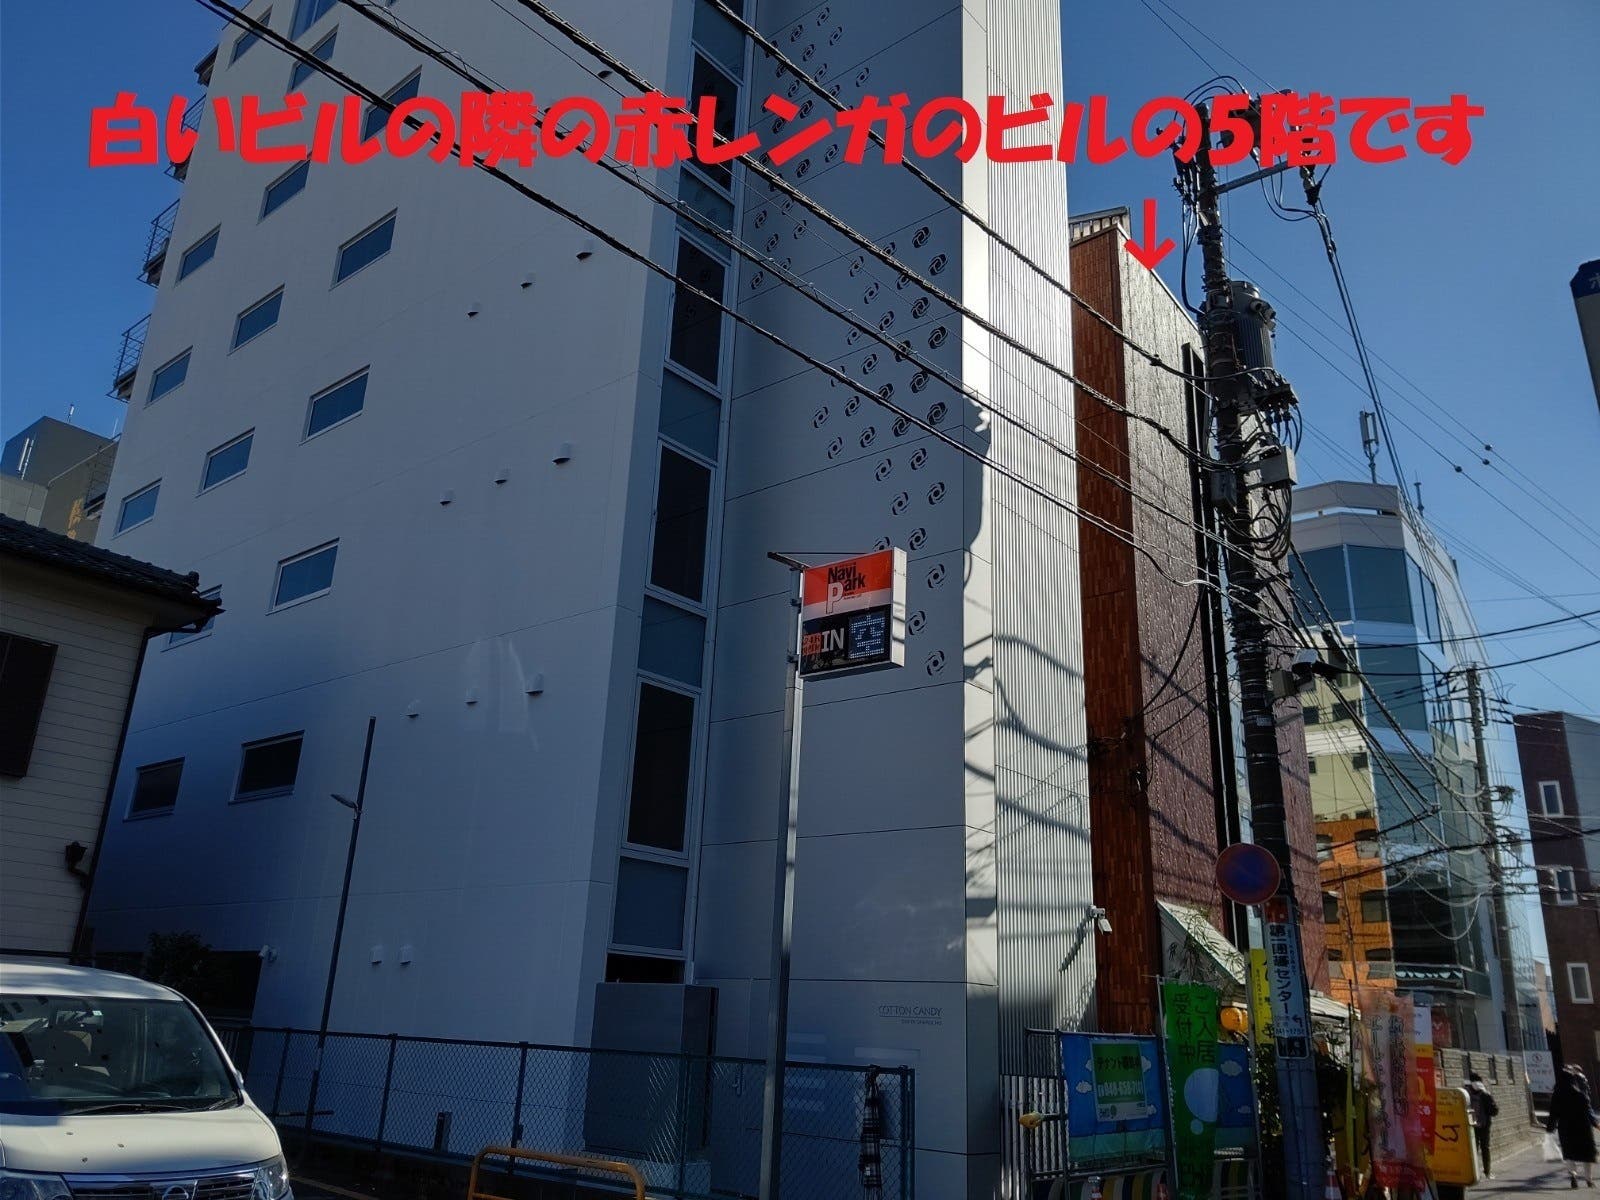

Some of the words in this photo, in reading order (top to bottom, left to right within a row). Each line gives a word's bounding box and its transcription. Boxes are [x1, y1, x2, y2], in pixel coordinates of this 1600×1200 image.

[828, 562, 856, 584] Navi
[826, 573, 866, 614] Park
[822, 627, 845, 653] IN
[913, 1006, 942, 1016] CANDY
[1174, 993, 1195, 1065] 受付中
